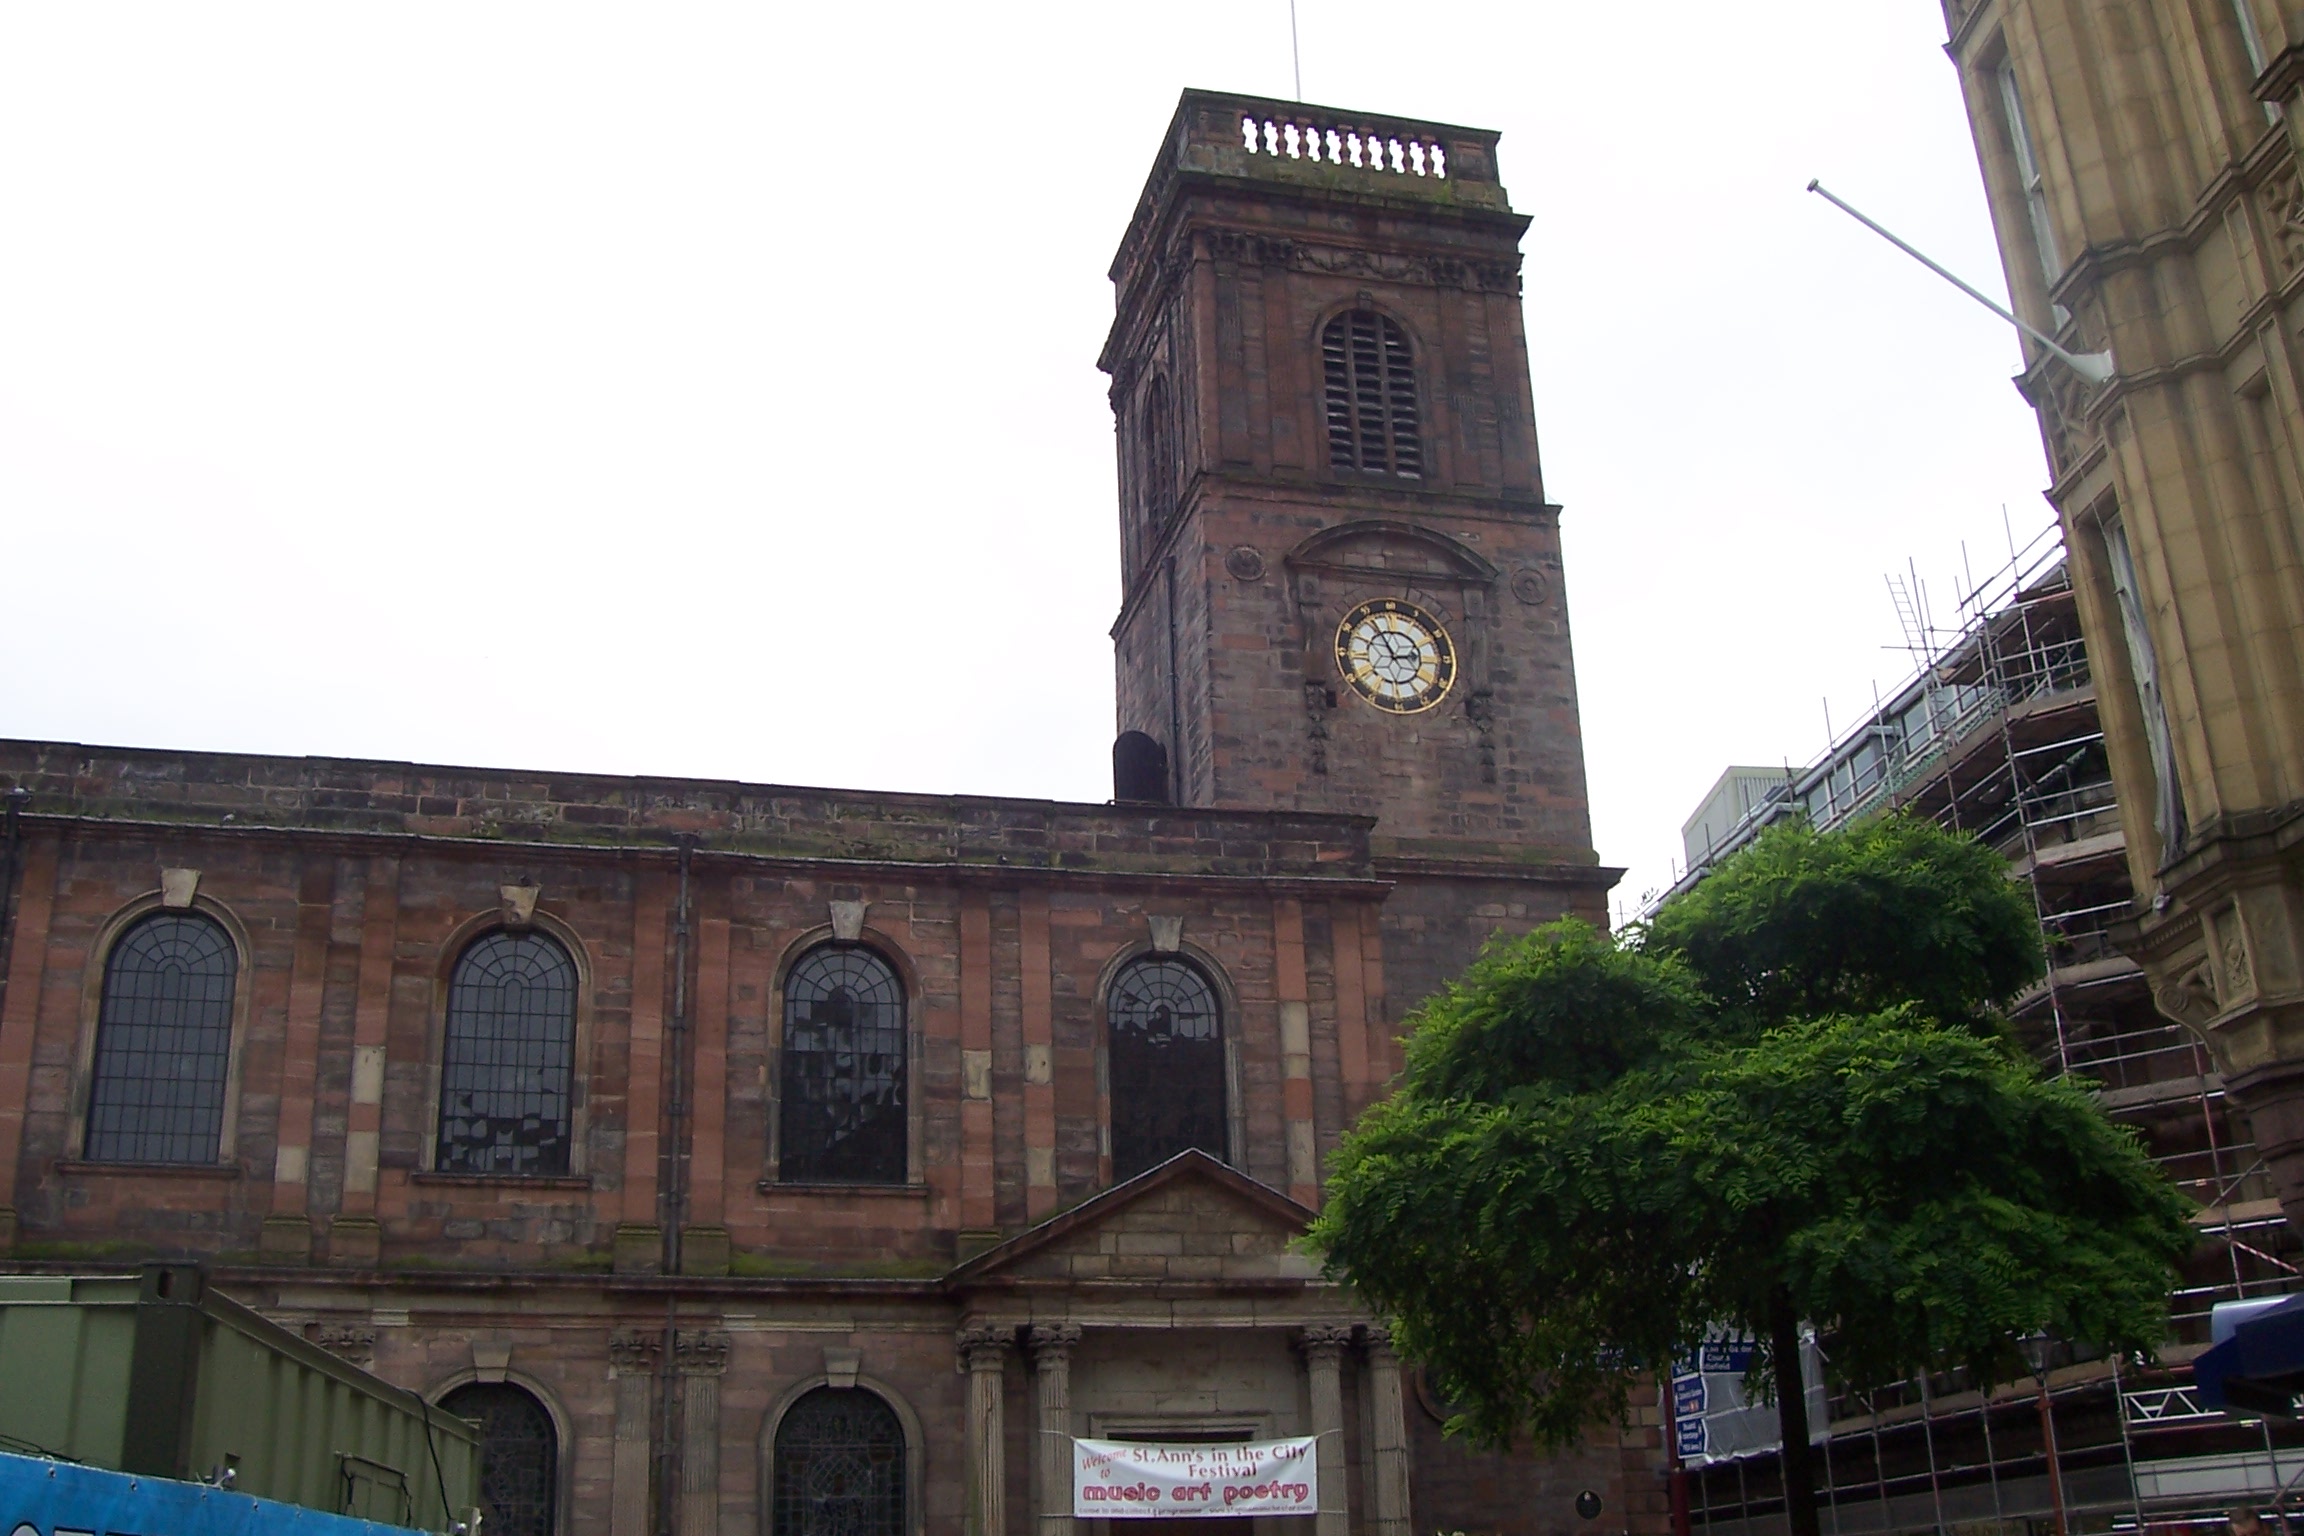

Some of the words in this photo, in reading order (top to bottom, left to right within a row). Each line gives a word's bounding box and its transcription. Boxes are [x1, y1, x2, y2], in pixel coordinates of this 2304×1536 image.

[1082, 1449, 1128, 1471] Welcome
[1212, 1447, 1228, 1462] in
[1236, 1446, 1264, 1461] the
[1272, 1445, 1309, 1464] City
[1100, 1468, 1111, 1479] to
[1189, 1462, 1257, 1478] Festival
[1083, 1481, 1161, 1502] music
[1171, 1481, 1212, 1502] art
[1223, 1480, 1308, 1505] poetry
